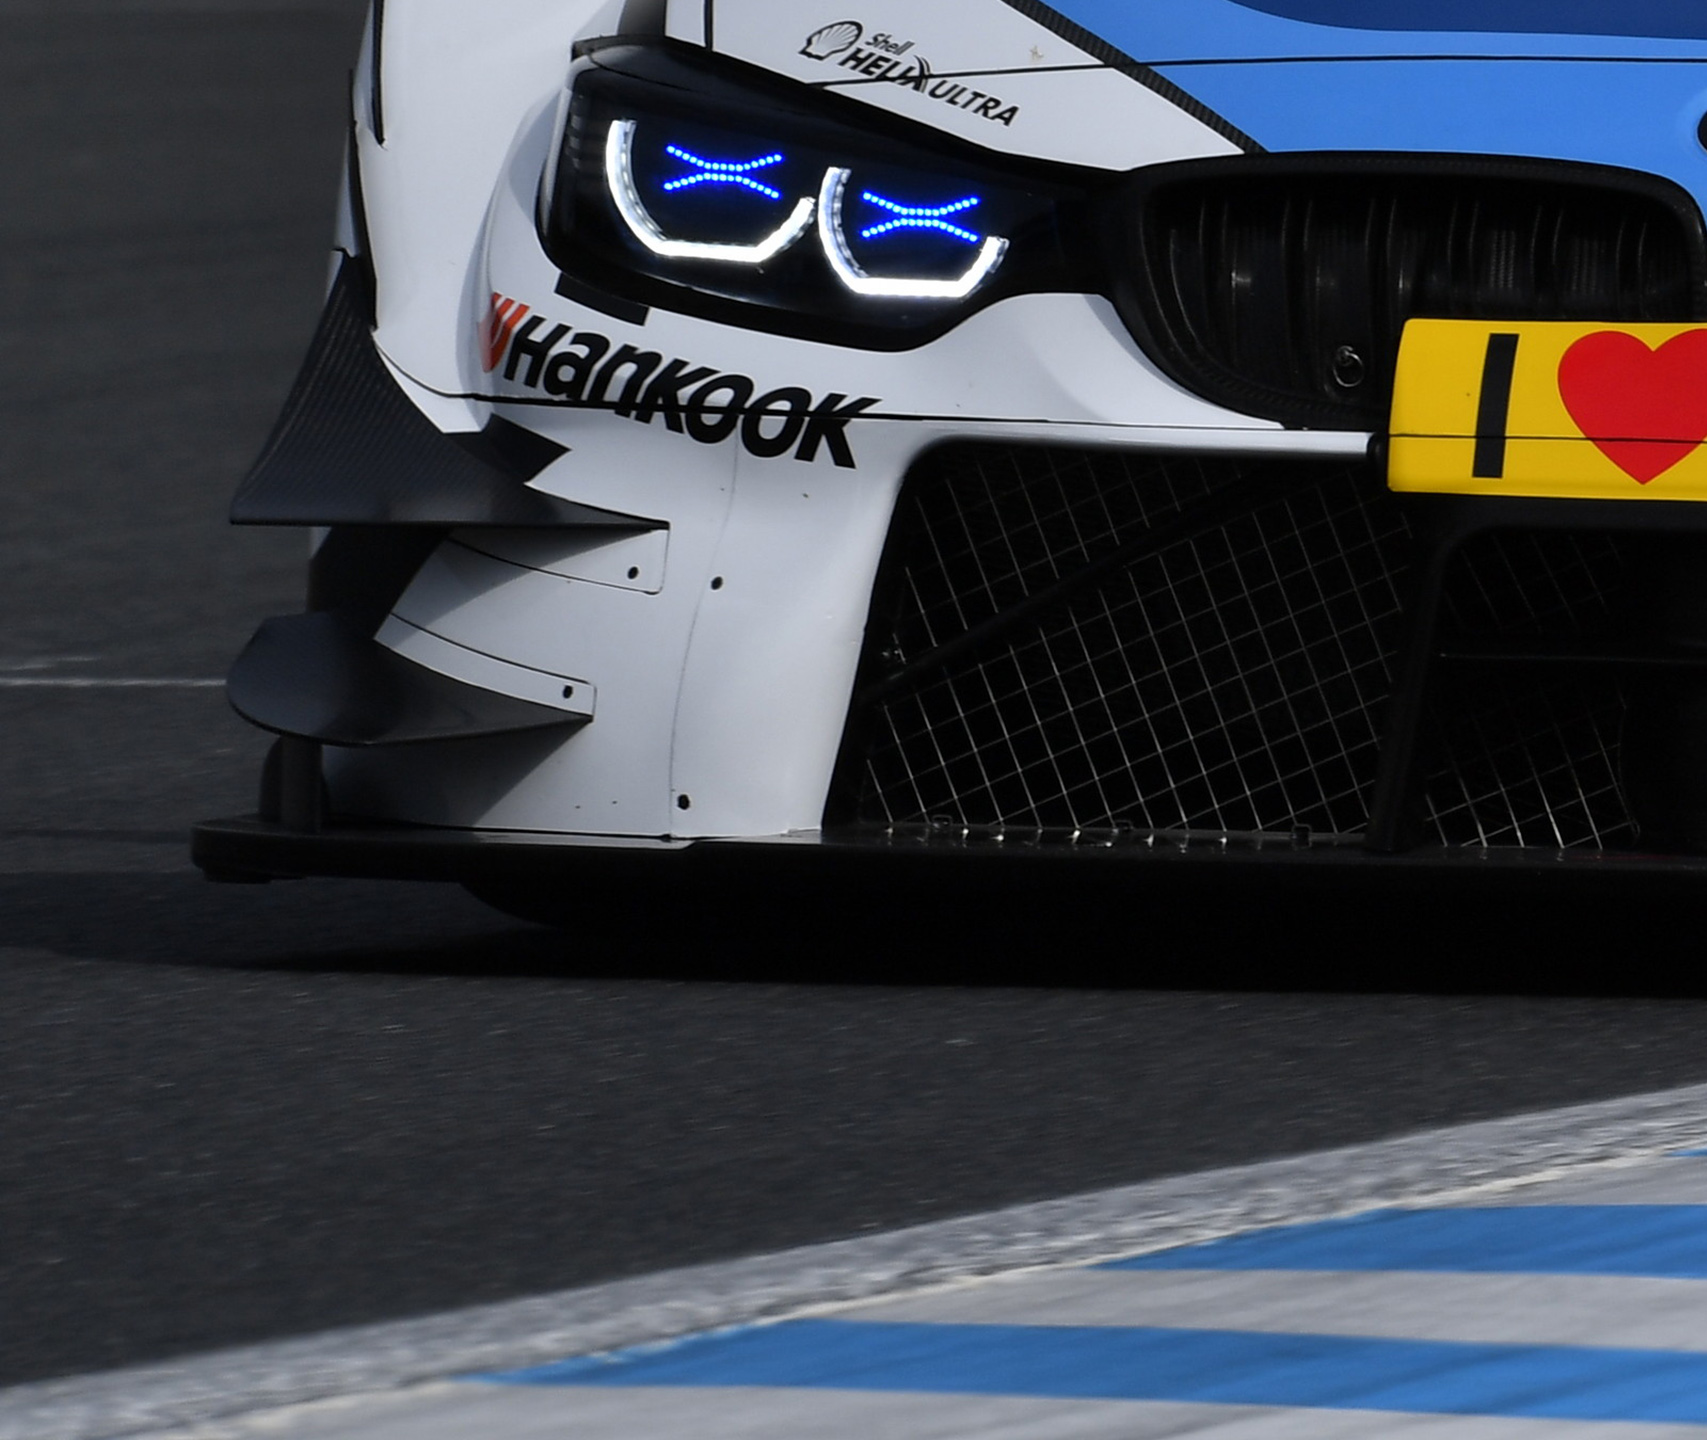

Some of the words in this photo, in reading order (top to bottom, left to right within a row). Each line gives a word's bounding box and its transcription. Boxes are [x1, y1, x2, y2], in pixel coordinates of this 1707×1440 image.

[866, 33, 916, 56] Shell
[927, 79, 1020, 127] ULTRA
[1472, 333, 1520, 479] I
